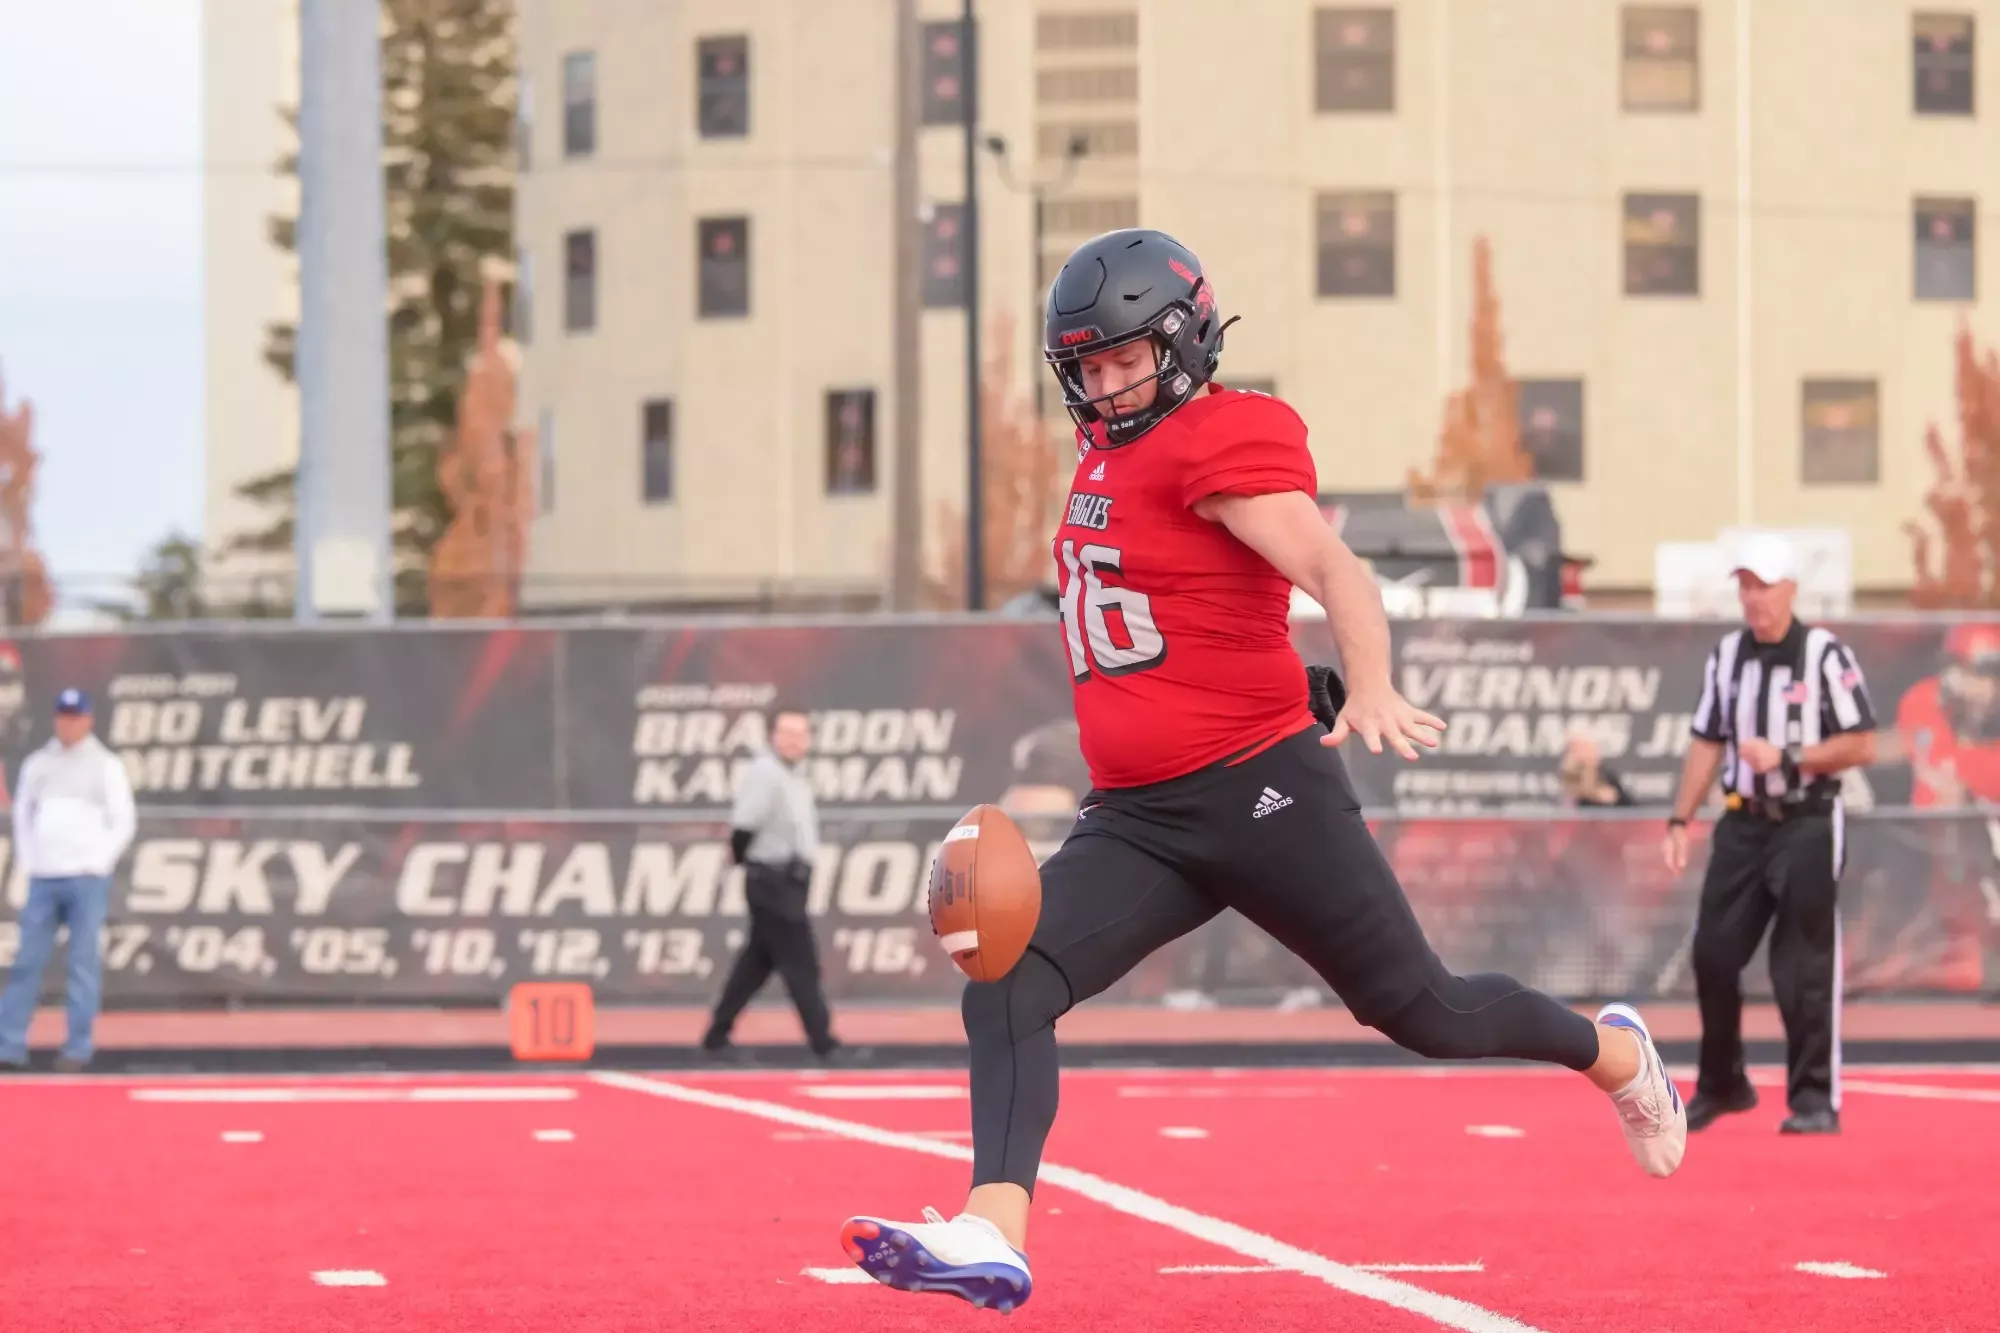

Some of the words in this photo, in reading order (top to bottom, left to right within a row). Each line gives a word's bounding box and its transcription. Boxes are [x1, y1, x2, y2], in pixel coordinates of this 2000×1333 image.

[1062, 329, 1092, 345] EWU
[1066, 493, 1113, 530] EAGLES
[1401, 664, 1661, 710] VERNON
[109, 699, 202, 745] BO
[219, 696, 367, 742] LEVI
[633, 708, 956, 755] BRADON
[633, 755, 963, 803] KAMAN
[1252, 797, 1293, 819] adidas
[125, 838, 363, 914] SKY
[528, 998, 576, 1046] 10
